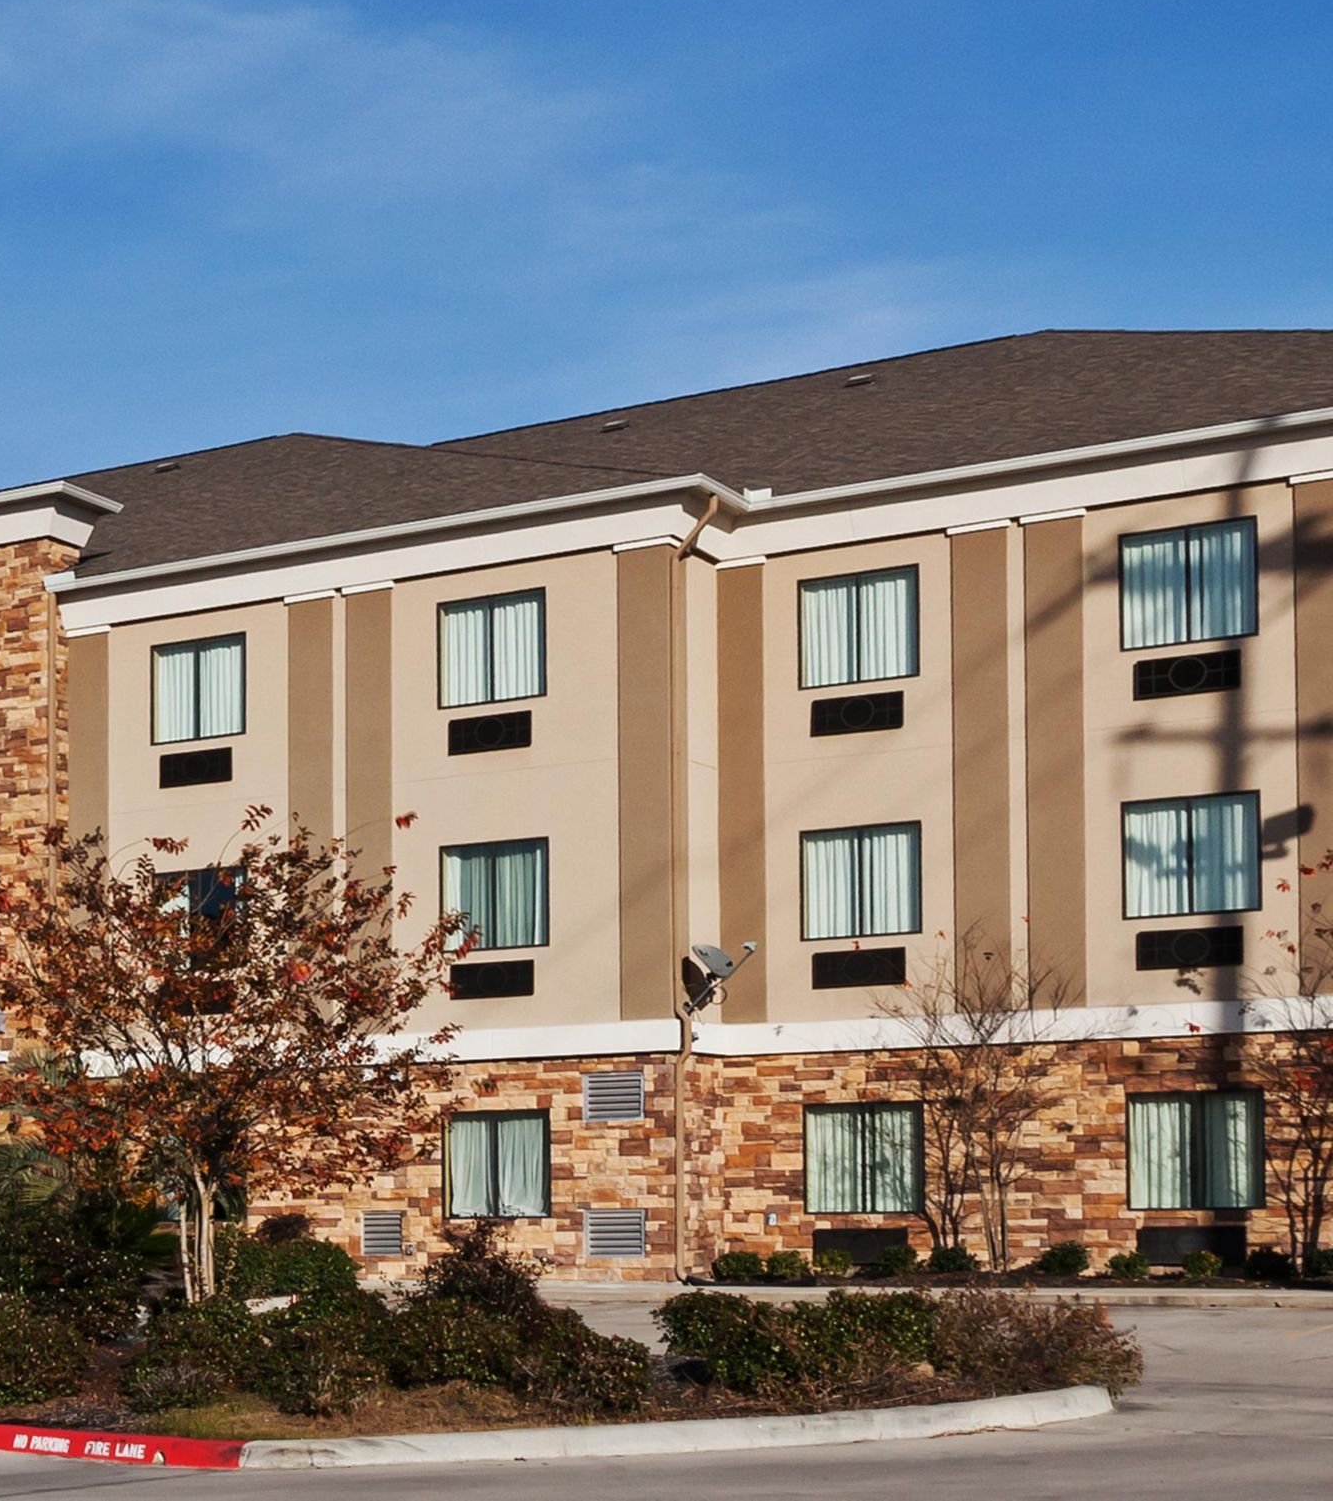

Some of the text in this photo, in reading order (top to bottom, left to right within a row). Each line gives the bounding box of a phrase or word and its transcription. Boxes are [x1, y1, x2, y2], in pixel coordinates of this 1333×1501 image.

[13, 1434, 146, 1459] NO PARKING FIRE LANE
